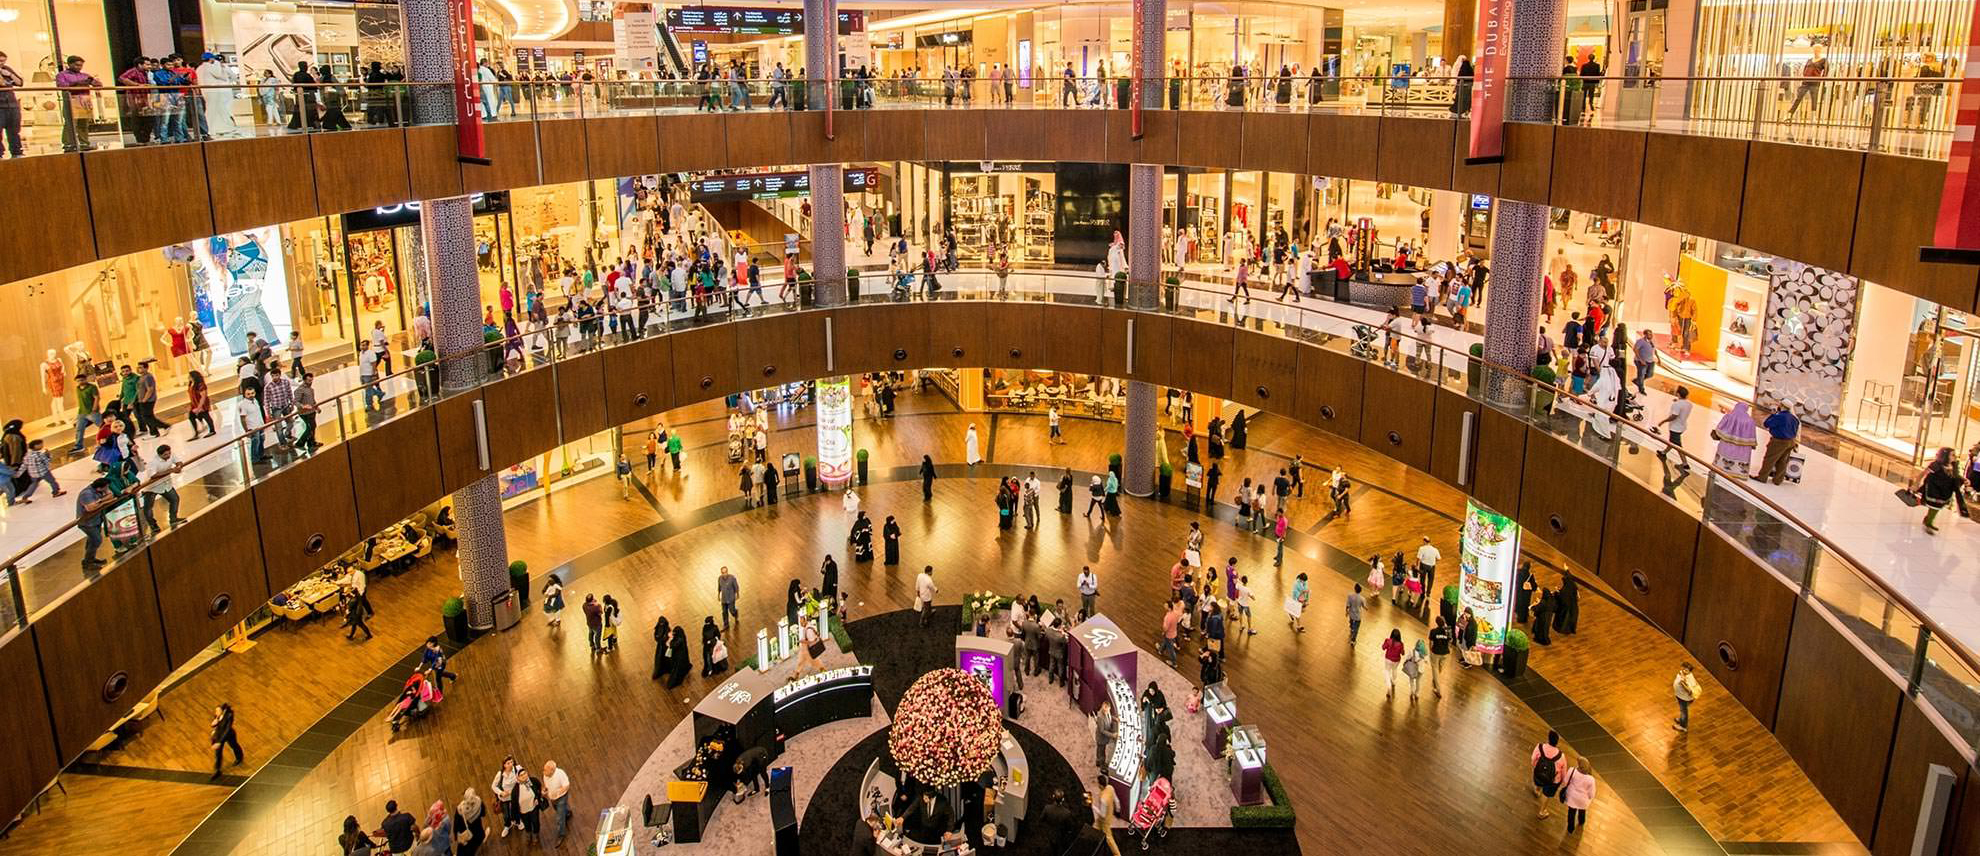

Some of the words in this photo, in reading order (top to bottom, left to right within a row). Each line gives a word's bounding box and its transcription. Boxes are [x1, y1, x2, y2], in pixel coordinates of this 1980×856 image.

[457, 2, 467, 53] مول
[854, 17, 859, 30] 1
[1500, 0, 1512, 56] Everything
[461, 60, 474, 117] دبي
[1484, 67, 1494, 99] THE
[866, 174, 876, 186] G
